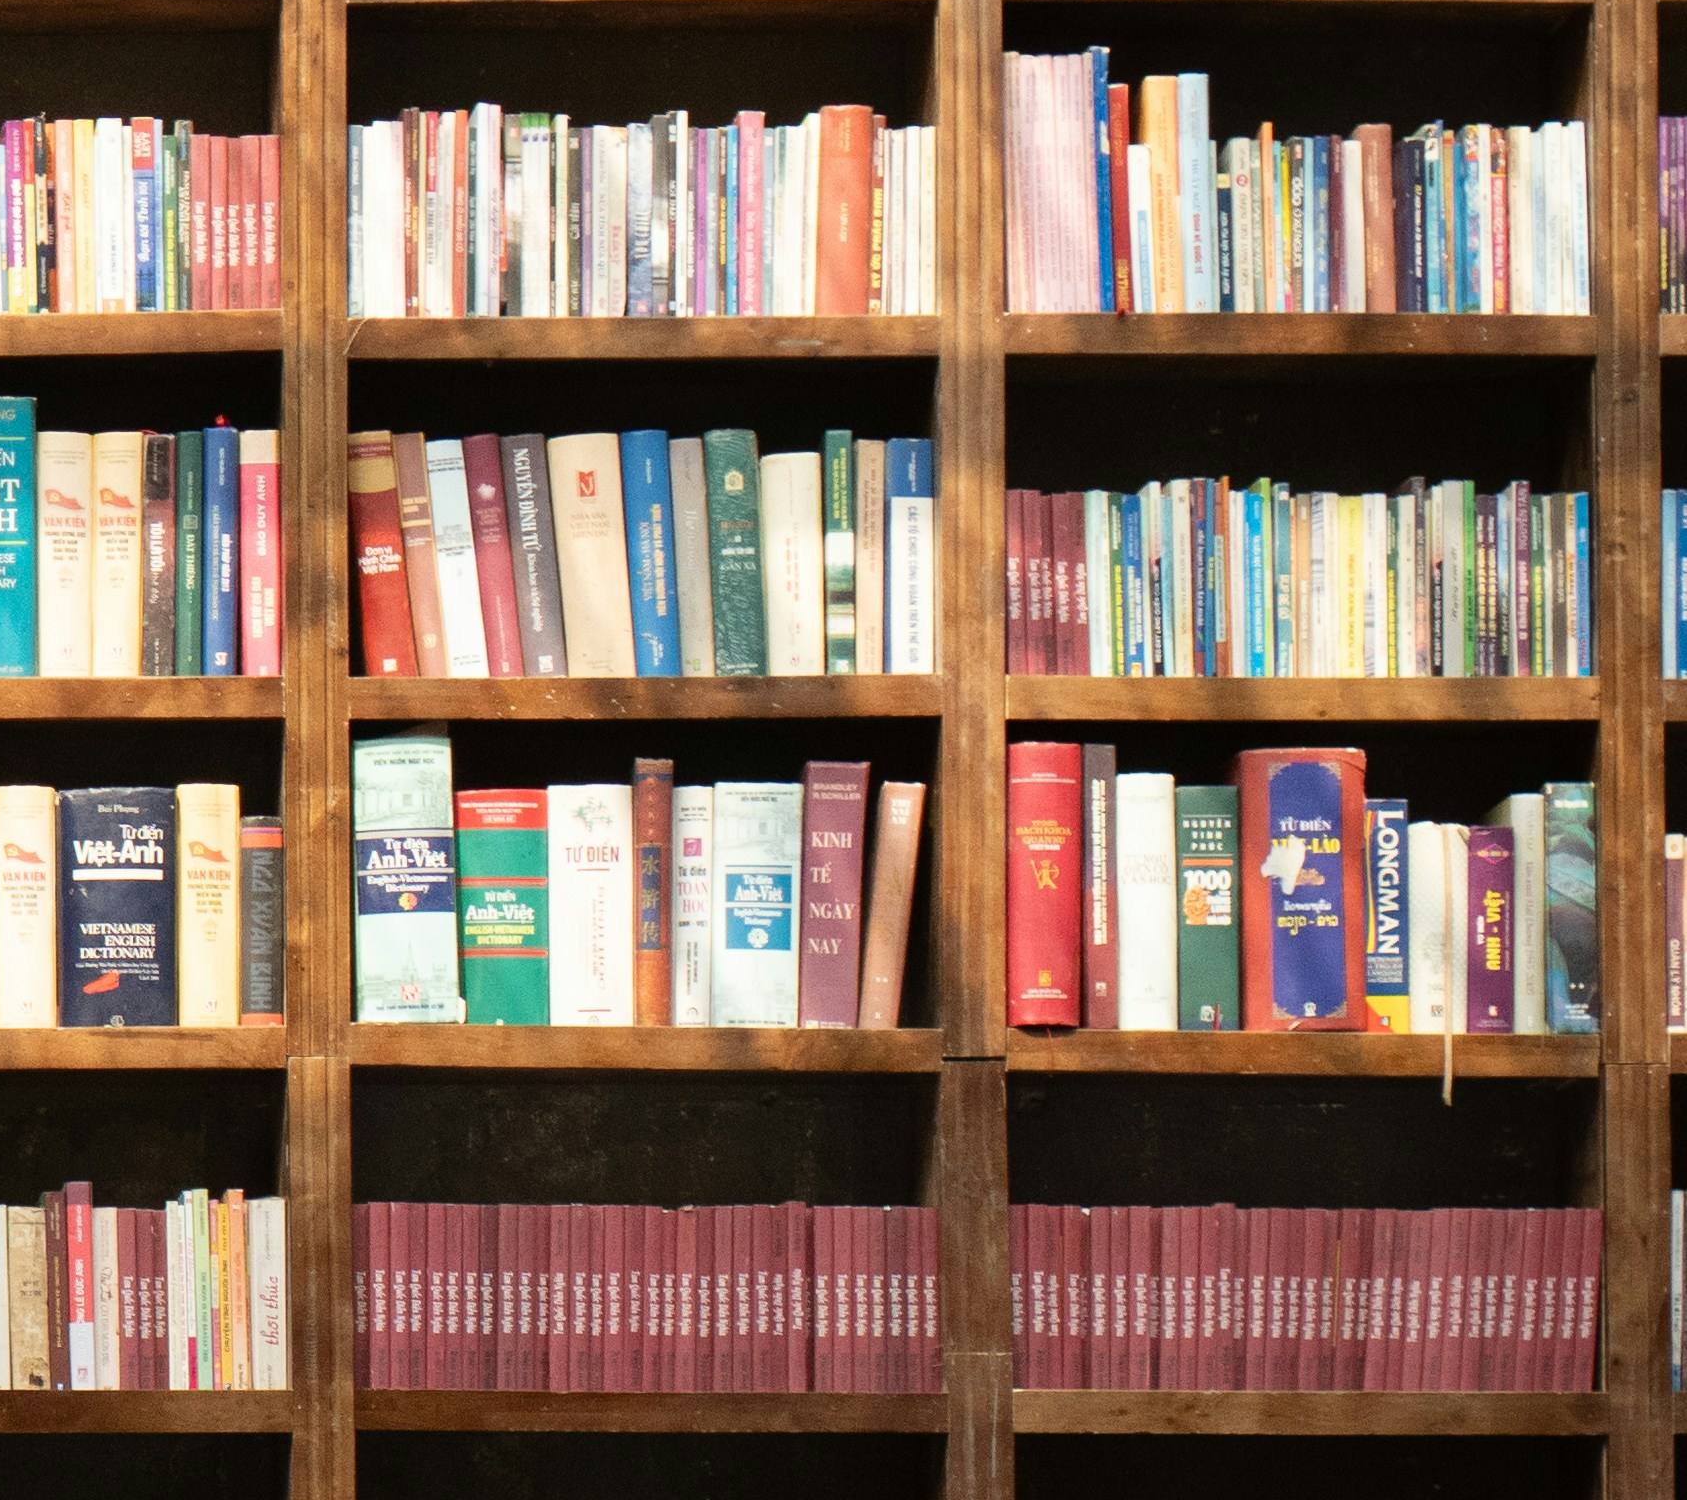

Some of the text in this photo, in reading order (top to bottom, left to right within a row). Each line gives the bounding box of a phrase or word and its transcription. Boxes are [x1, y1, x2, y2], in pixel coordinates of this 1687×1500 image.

[134, 131, 142, 158] MARC
[142, 131, 152, 158] LEVY
[257, 475, 267, 501] ANH
[256, 504, 267, 528] DUY
[119, 824, 163, 840] Từ điển
[1279, 818, 1332, 832] TỪ ĐIỂN
[811, 831, 853, 849] KINH
[73, 839, 164, 868] Việt-Anh
[367, 849, 448, 870] Anh-Việt
[565, 841, 620, 863] TỪ ĐIỂN
[367, 873, 448, 885] English-Vietnamese
[811, 862, 832, 884] TẾ
[1183, 870, 1232, 891] 1000
[1377, 810, 1404, 954] LONGMAN
[385, 883, 430, 893] Dictionary
[734, 884, 783, 903] Anh-Việt
[466, 904, 535, 925] Anh-Việt
[809, 898, 855, 920] NGÀY
[79, 923, 156, 935] VIETNAMESE
[1482, 890, 1506, 971] ANH VIỆT
[104, 935, 156, 947] ENGLISH
[808, 938, 842, 955] NAY
[79, 947, 156, 959] DICTIONARY
